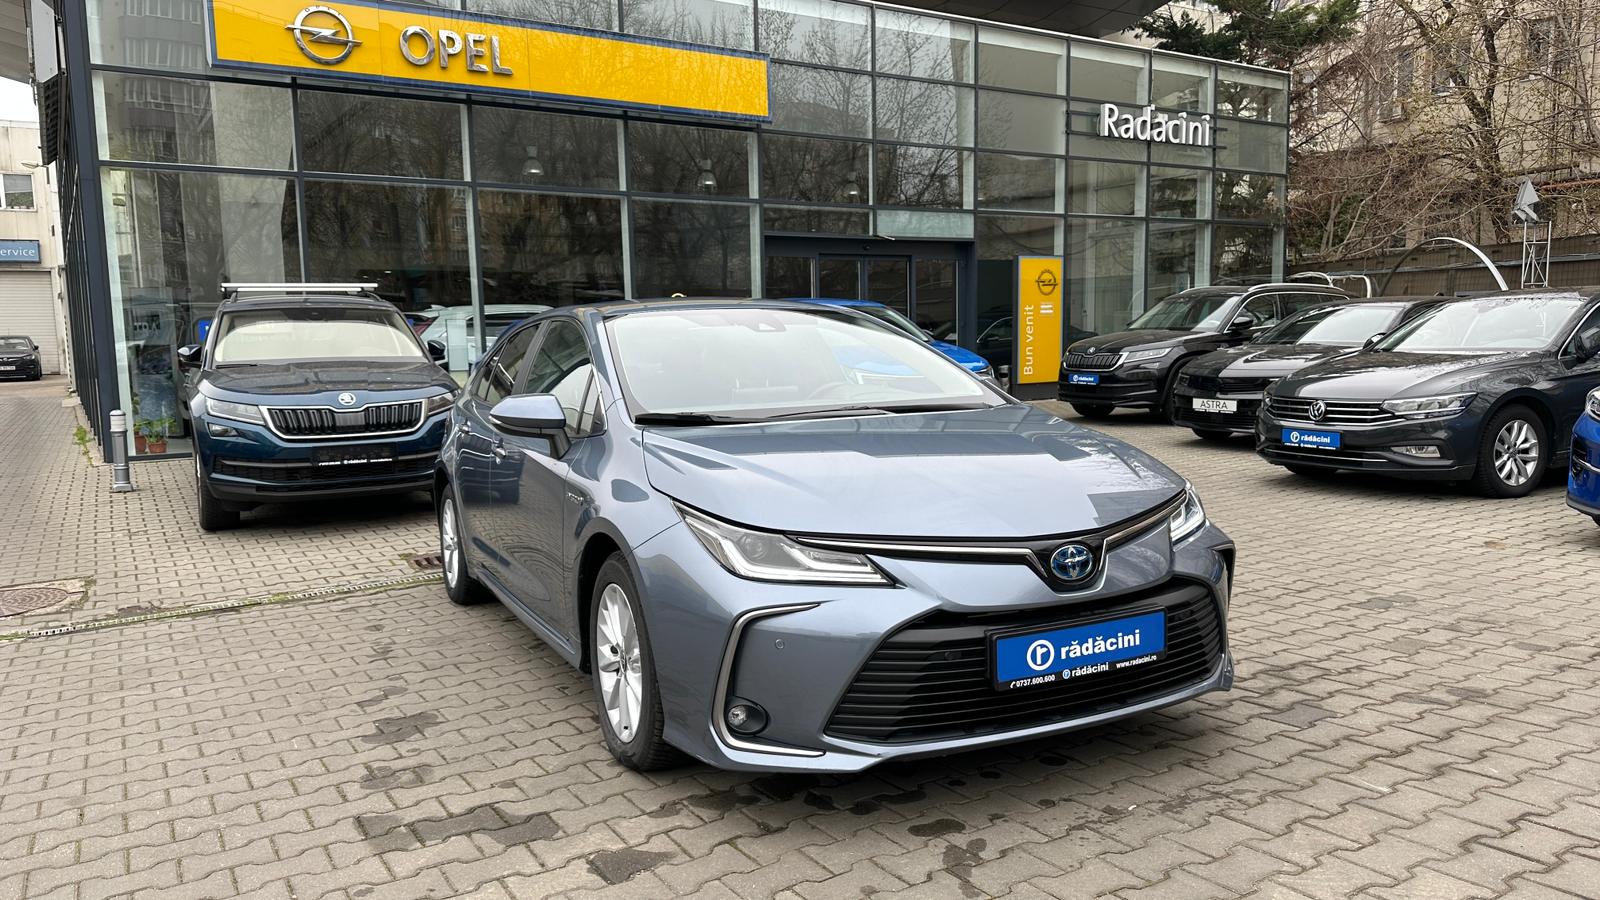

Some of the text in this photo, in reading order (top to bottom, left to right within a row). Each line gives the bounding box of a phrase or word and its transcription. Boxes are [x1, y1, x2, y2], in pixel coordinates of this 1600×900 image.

[400, 25, 512, 76] OPEL
[1023, 304, 1034, 375] Bun venit
[1200, 400, 1228, 409] ASTRA
[1060, 629, 1140, 660] rădăcini
[1016, 674, 1056, 687] 0737.600.600
[1071, 662, 1109, 677] rădăcini
